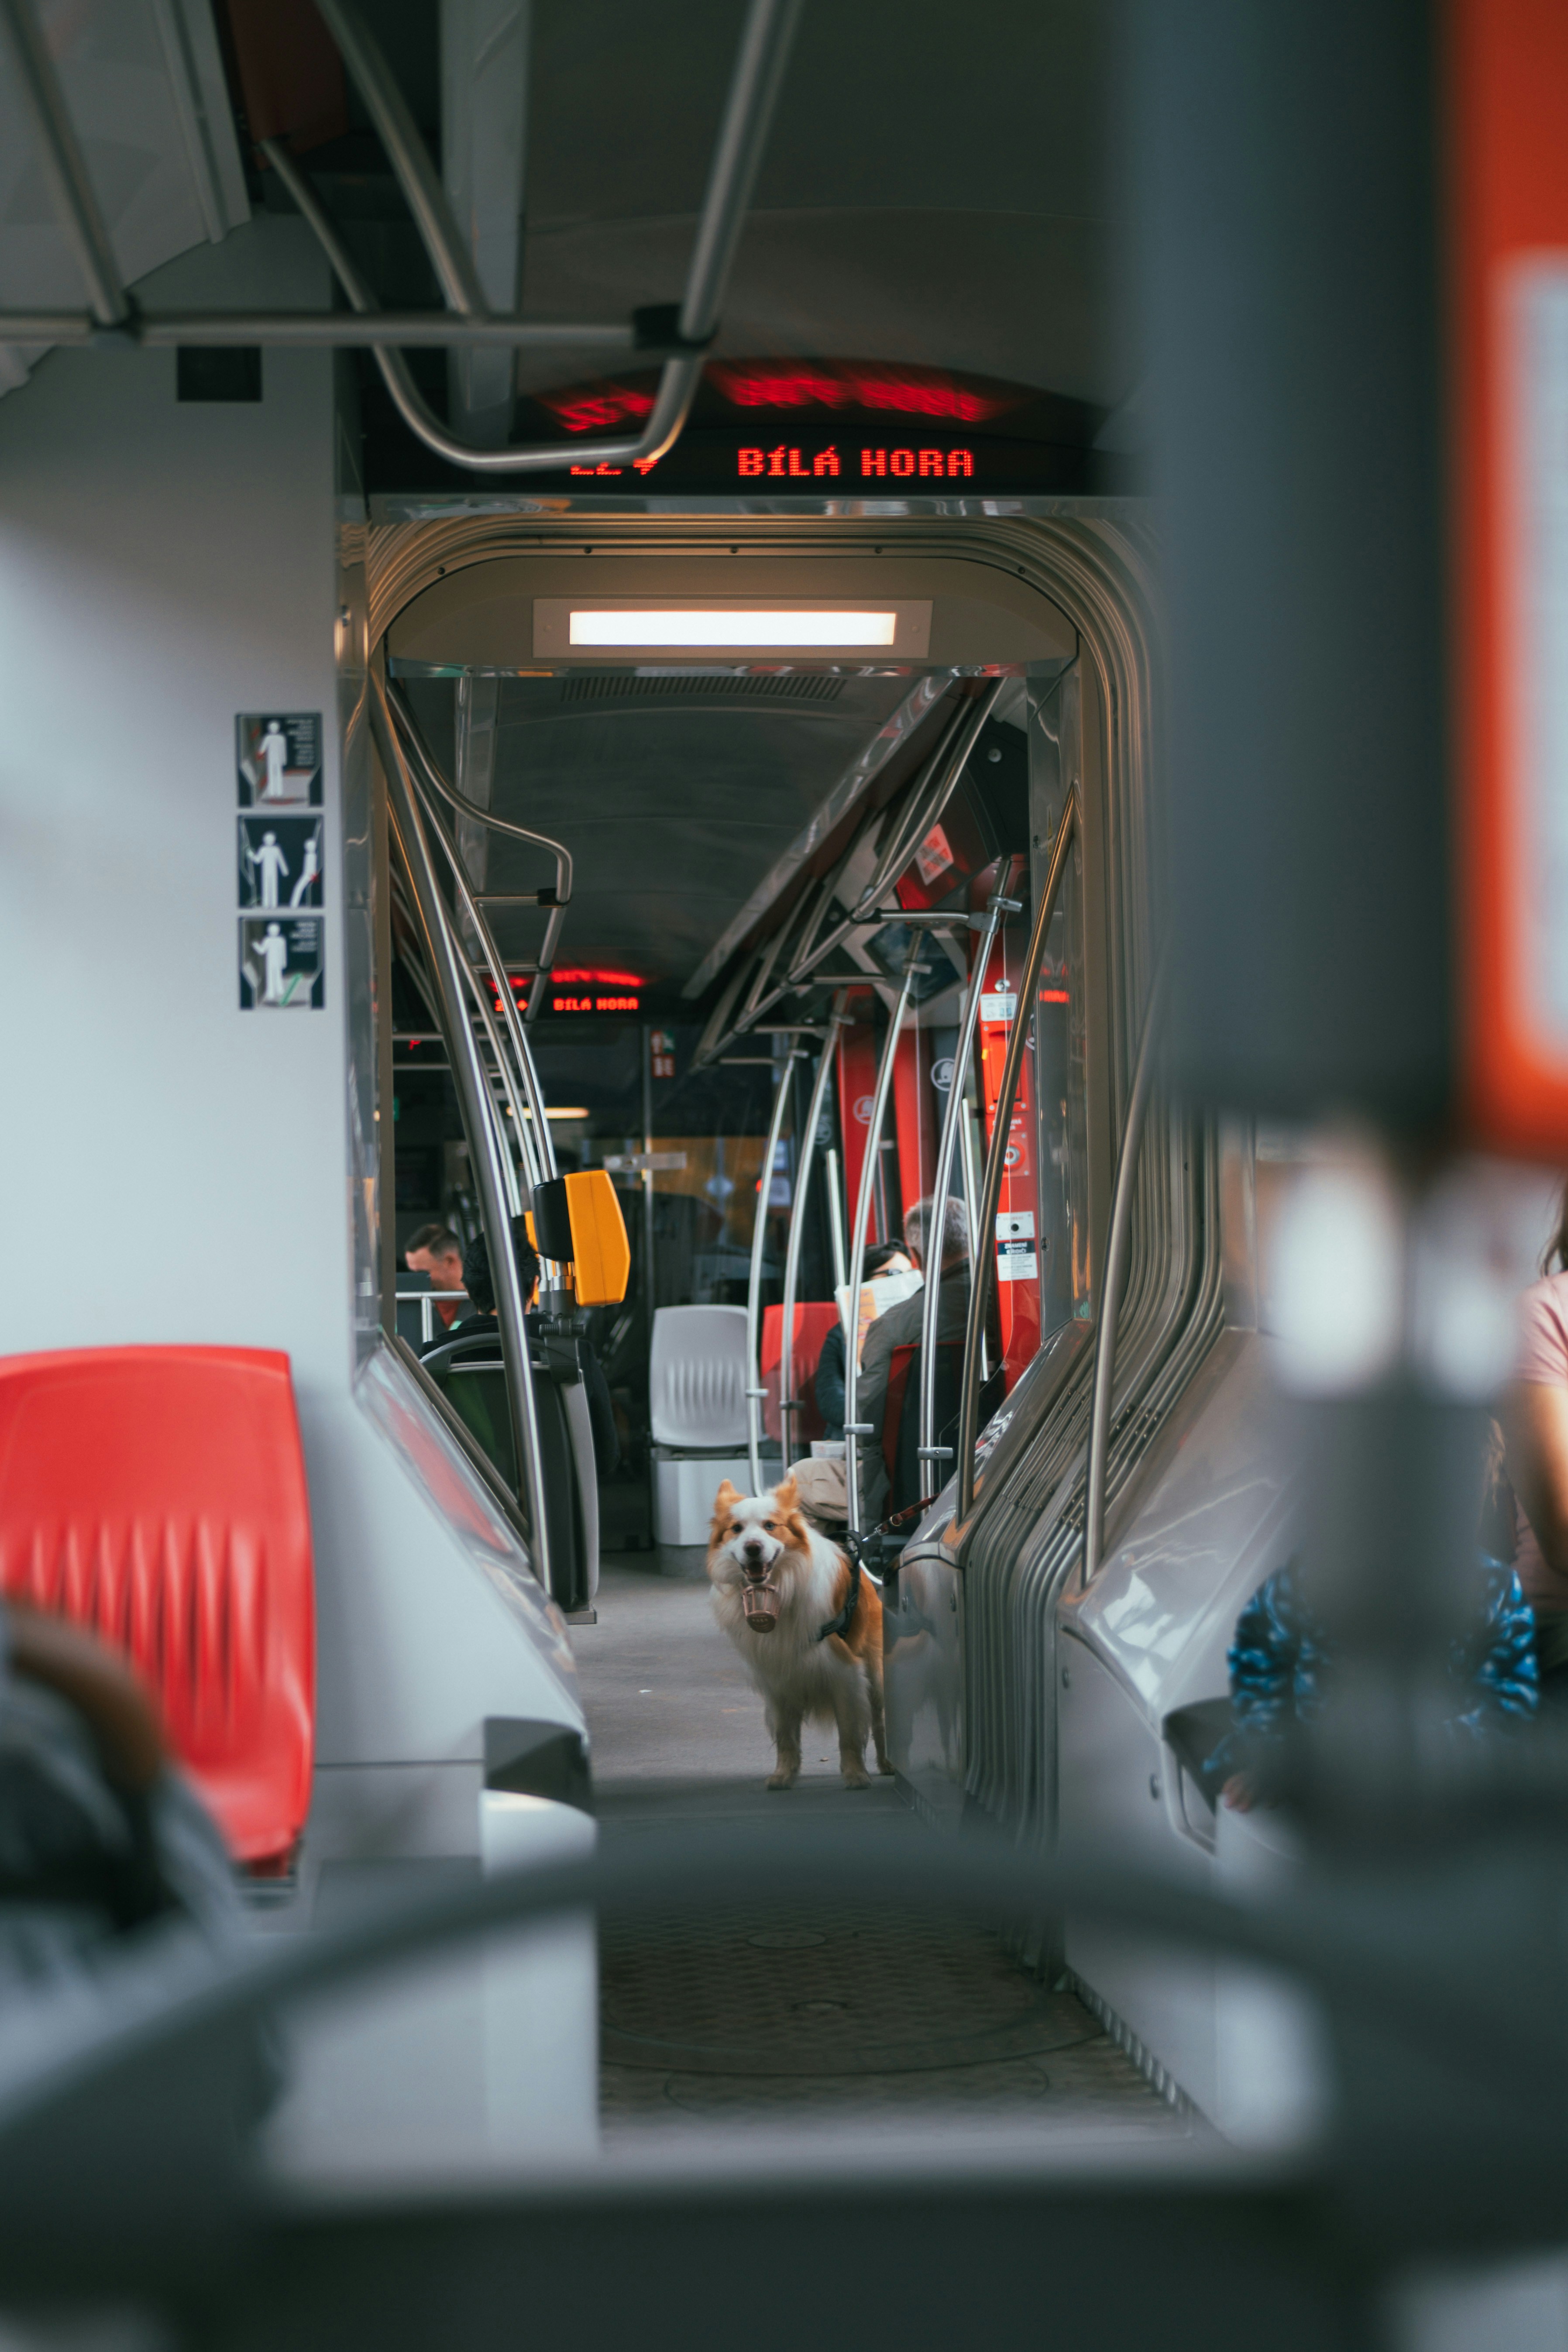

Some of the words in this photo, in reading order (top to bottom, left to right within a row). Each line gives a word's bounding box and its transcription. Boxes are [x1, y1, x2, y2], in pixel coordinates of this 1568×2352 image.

[738, 445, 839, 476] BÍLÁ
[861, 449, 973, 476] HORA
[554, 997, 591, 1010] BÍLÁ
[596, 997, 638, 1010] HORA
